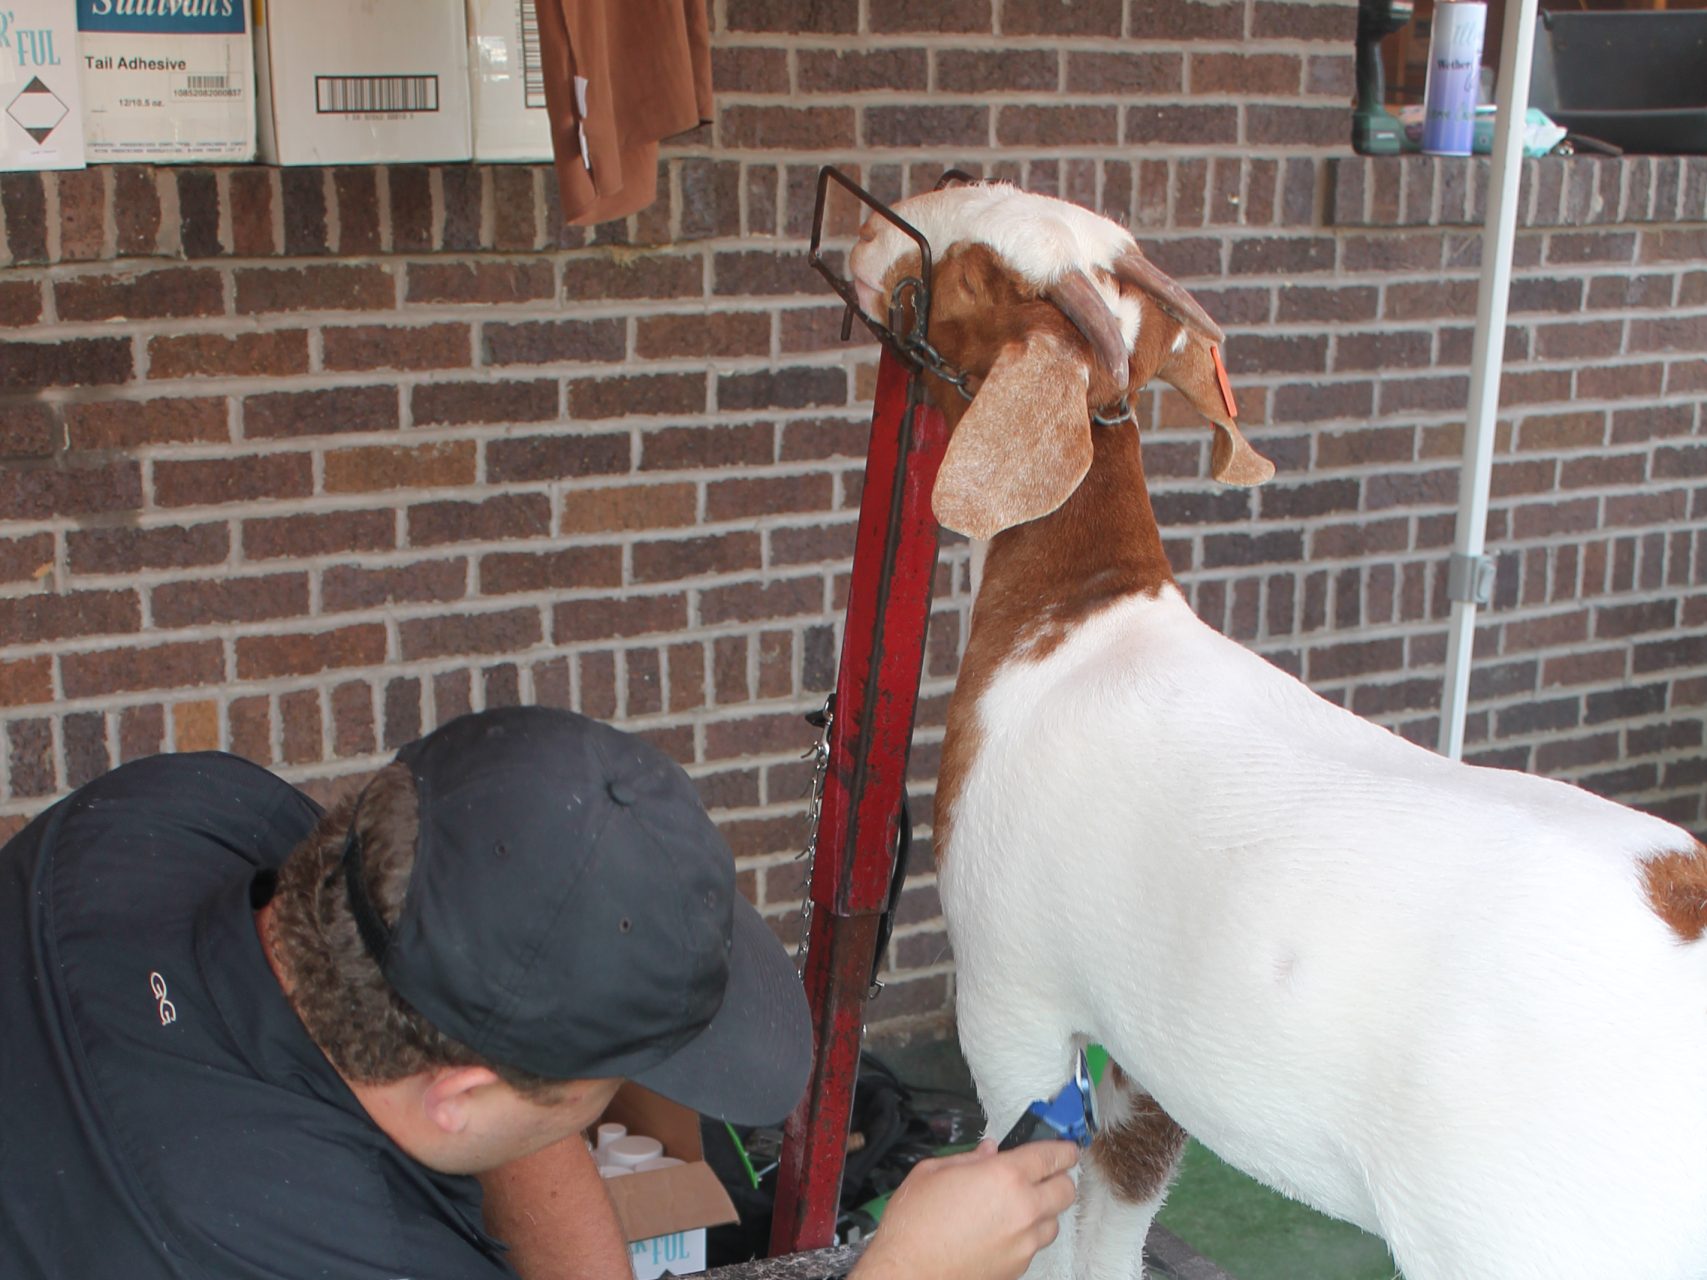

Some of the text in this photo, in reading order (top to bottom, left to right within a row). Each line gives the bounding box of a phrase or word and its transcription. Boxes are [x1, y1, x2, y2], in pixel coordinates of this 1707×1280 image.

[92, 0, 234, 17] Sullivans
[15, 29, 61, 66] FUL
[84, 56, 186, 70] Tail Adhesive
